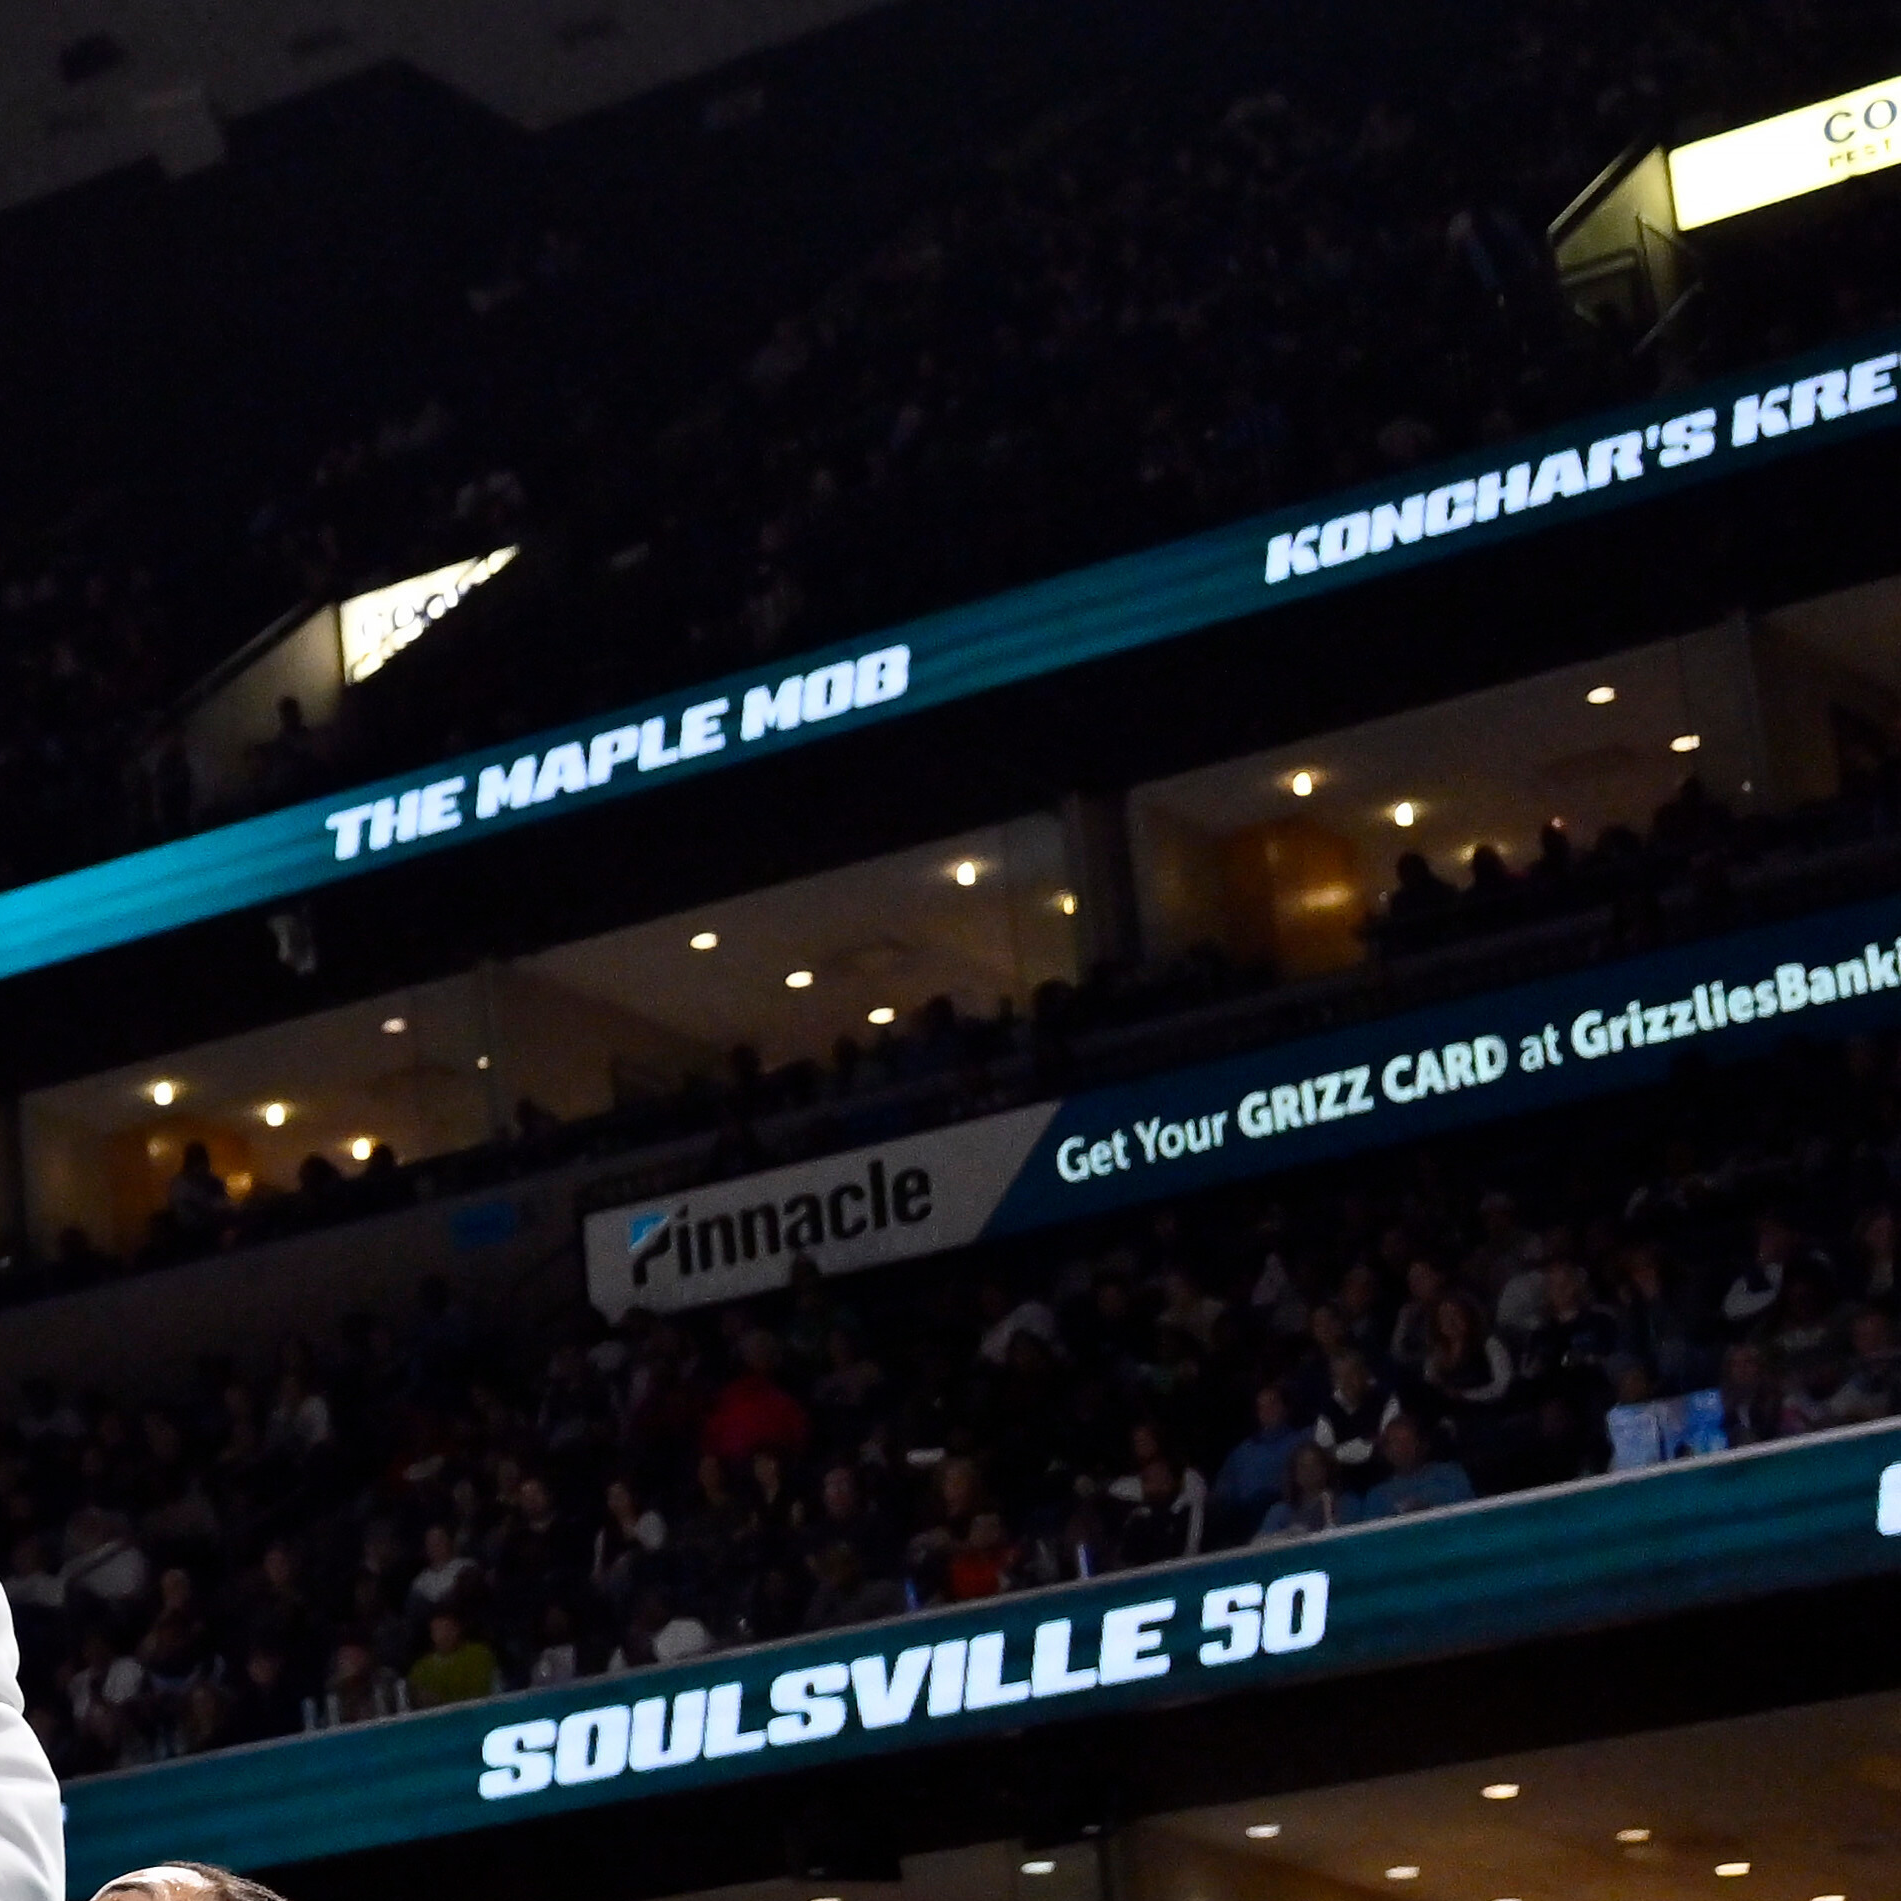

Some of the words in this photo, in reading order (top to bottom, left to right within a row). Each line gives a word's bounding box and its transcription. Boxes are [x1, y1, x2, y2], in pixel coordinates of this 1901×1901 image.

[1264, 407, 1717, 585] KONCHAR'S
[1731, 351, 1901, 448] KRE
[325, 776, 465, 860] THE
[476, 697, 730, 818] MAPLE
[740, 643, 911, 742] MOB
[1056, 1133, 1131, 1184] Get
[1134, 1107, 1229, 1164] Your
[1236, 1064, 1375, 1139] GRIZZ
[1381, 1034, 1509, 1103] CARD
[1518, 1022, 1564, 1074] at
[629, 1159, 934, 1287] Pinnacle
[477, 1599, 1178, 1802] SOULSVILLE
[1198, 1570, 1331, 1668] 50
